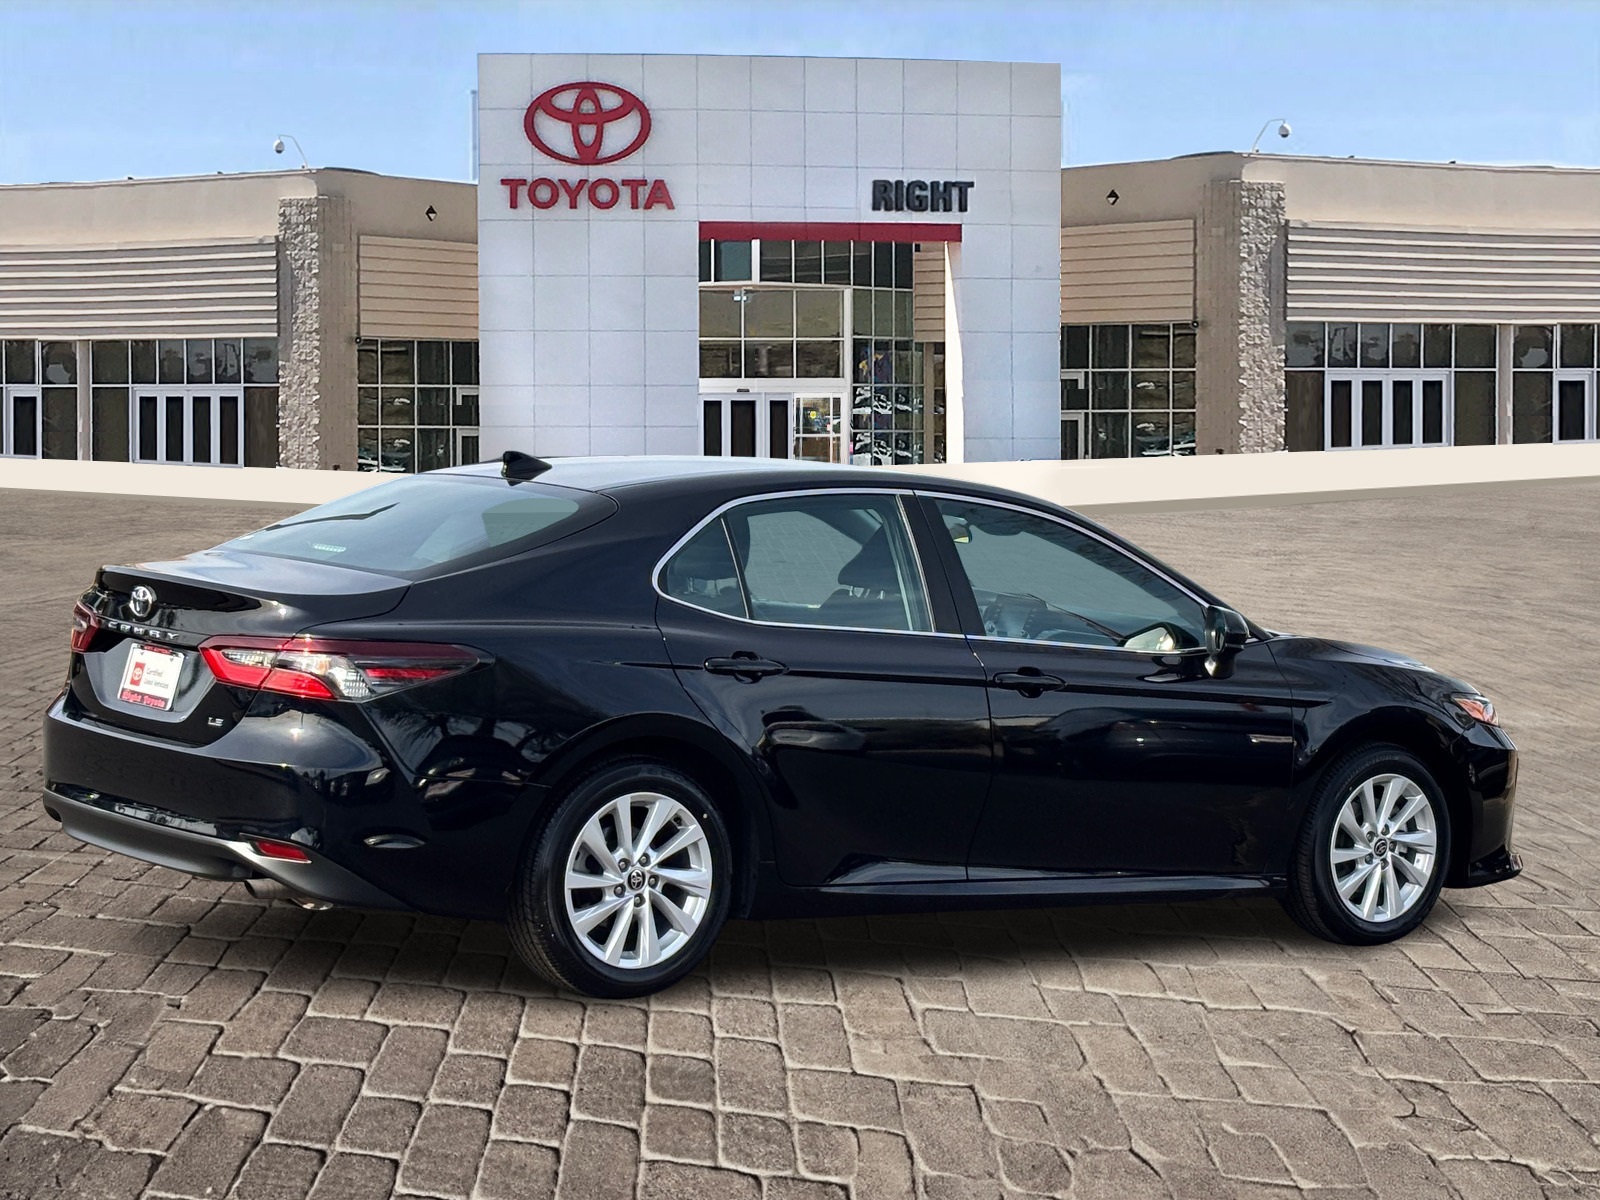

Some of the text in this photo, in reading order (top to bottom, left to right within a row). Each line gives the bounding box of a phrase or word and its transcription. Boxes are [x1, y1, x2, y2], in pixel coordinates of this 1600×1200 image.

[500, 178, 676, 210] TOYOTA
[871, 179, 977, 212] RIGHT
[108, 621, 179, 639] CAMRY
[208, 717, 224, 726] LE
